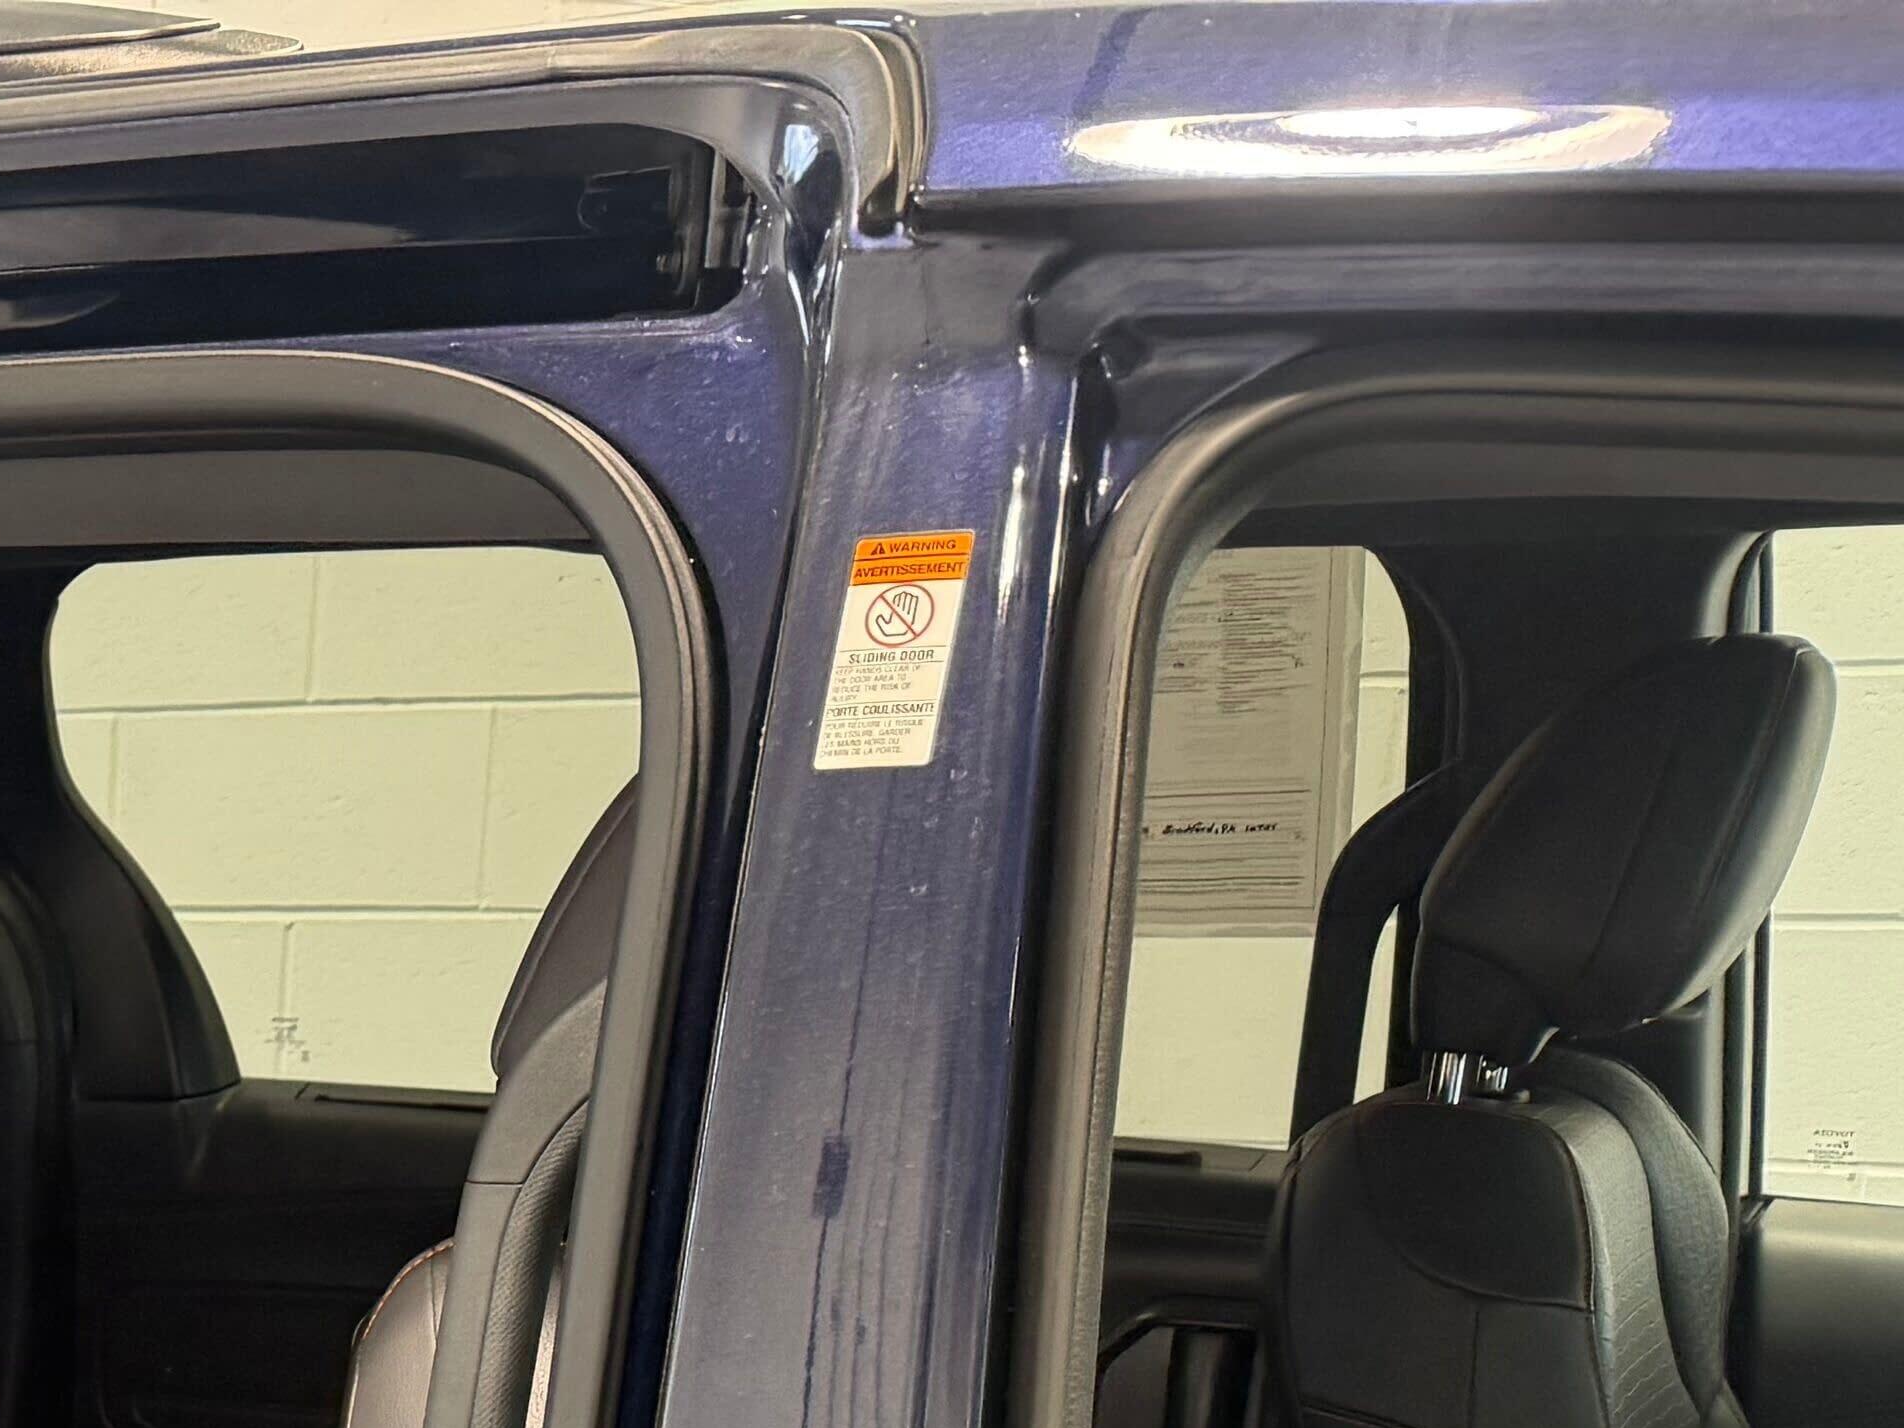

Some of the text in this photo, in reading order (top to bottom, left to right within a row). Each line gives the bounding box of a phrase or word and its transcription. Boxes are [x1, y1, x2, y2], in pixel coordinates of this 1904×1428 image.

[889, 539, 956, 553] WARNING
[854, 562, 965, 579] AVERTISSEMENT
[848, 649, 934, 664] SLIDING DOOR
[826, 702, 935, 718] PORTE COULISSANTE
